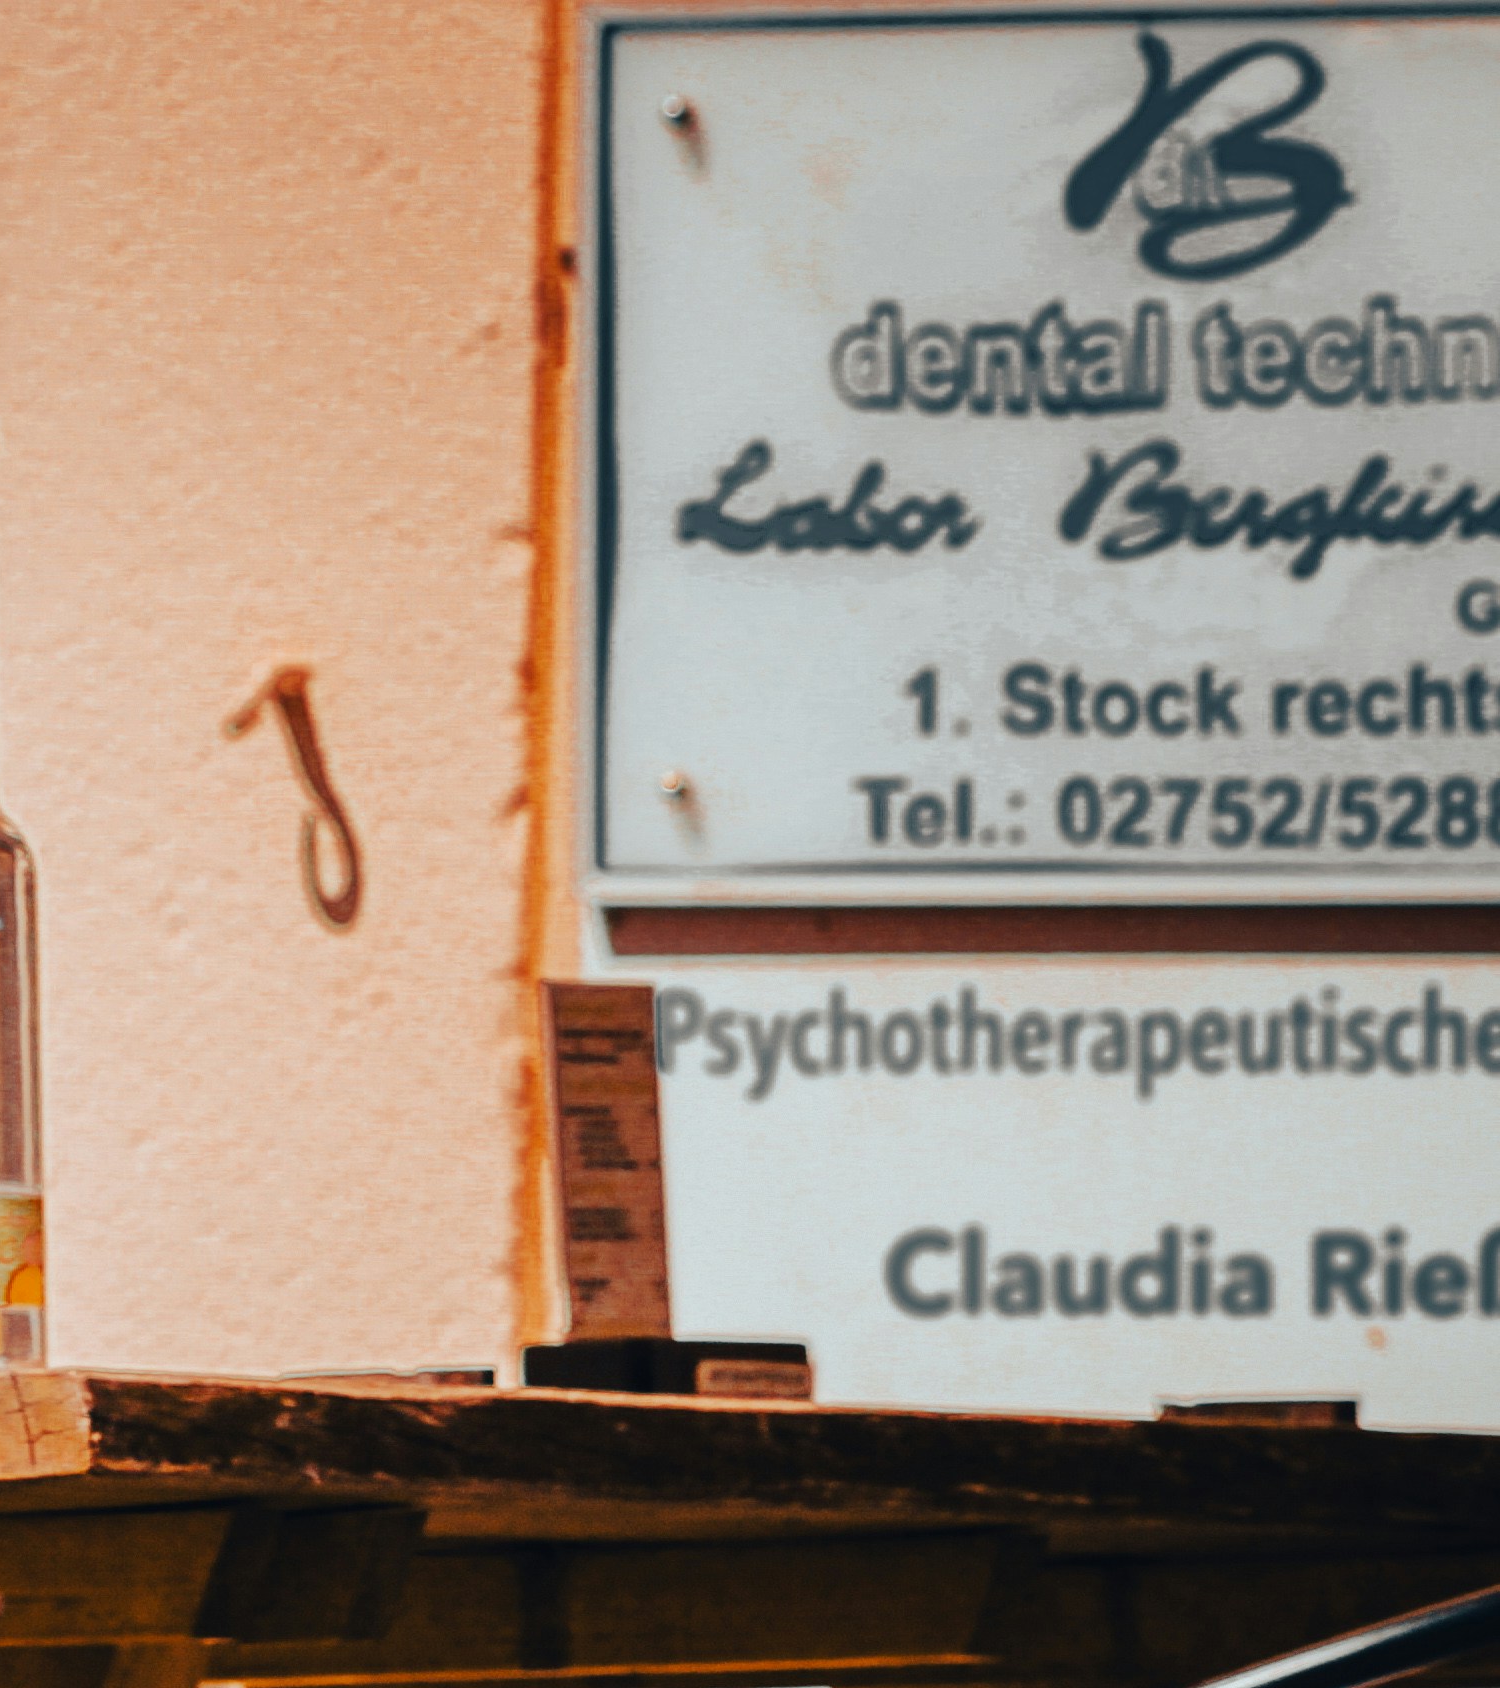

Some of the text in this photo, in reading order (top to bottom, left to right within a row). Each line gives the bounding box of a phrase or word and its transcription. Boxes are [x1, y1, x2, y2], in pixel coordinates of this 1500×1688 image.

[831, 298, 1170, 415] dental
[674, 439, 987, 555] Labor
[908, 662, 1500, 738] 1. Stock recht
[856, 777, 1026, 847] Tel.:
[884, 1223, 1276, 1319] Claudia
